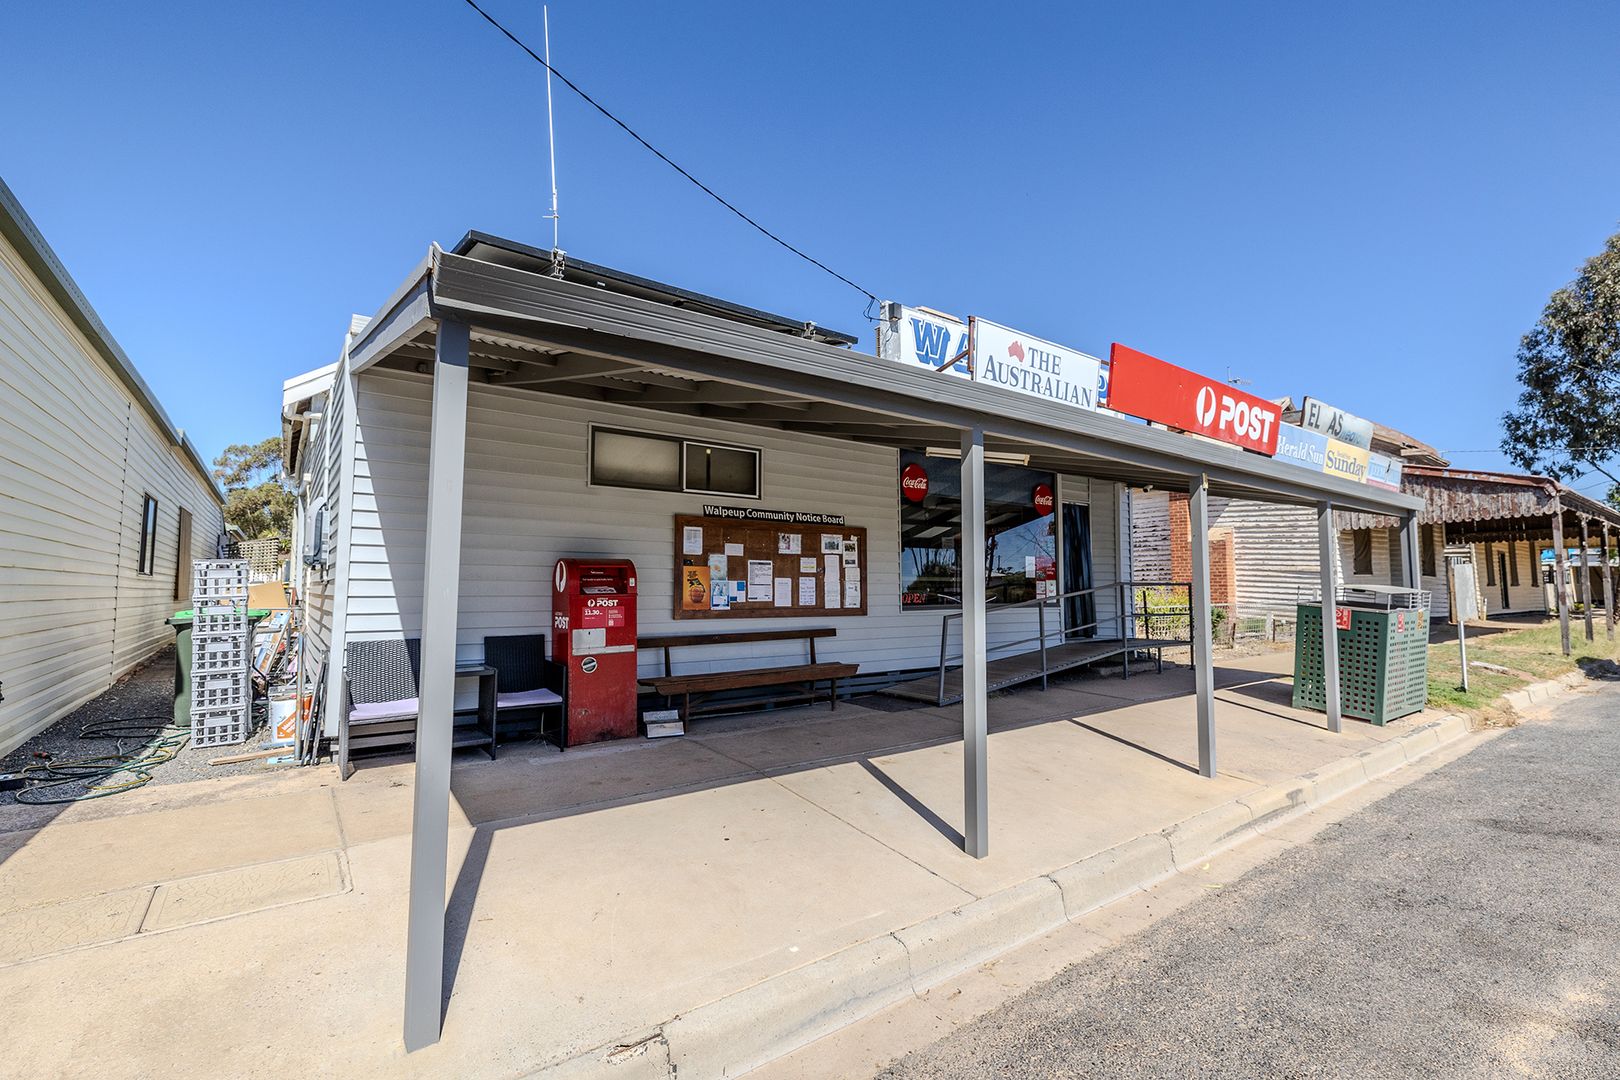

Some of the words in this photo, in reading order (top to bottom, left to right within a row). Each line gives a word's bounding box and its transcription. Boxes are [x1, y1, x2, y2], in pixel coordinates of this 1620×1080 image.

[1028, 346, 1062, 376] THE
[982, 355, 1093, 408] AUSTRALIAN
[1219, 395, 1275, 443] POST
[1277, 435, 1308, 460] Herald
[1308, 444, 1324, 465] Sun
[1326, 450, 1367, 480] Sunday
[704, 505, 745, 519] Walpeup
[746, 508, 794, 522] Community
[795, 512, 821, 523] Notice
[822, 514, 844, 524] Board
[596, 599, 619, 607] POST
[554, 616, 570, 630] POST
